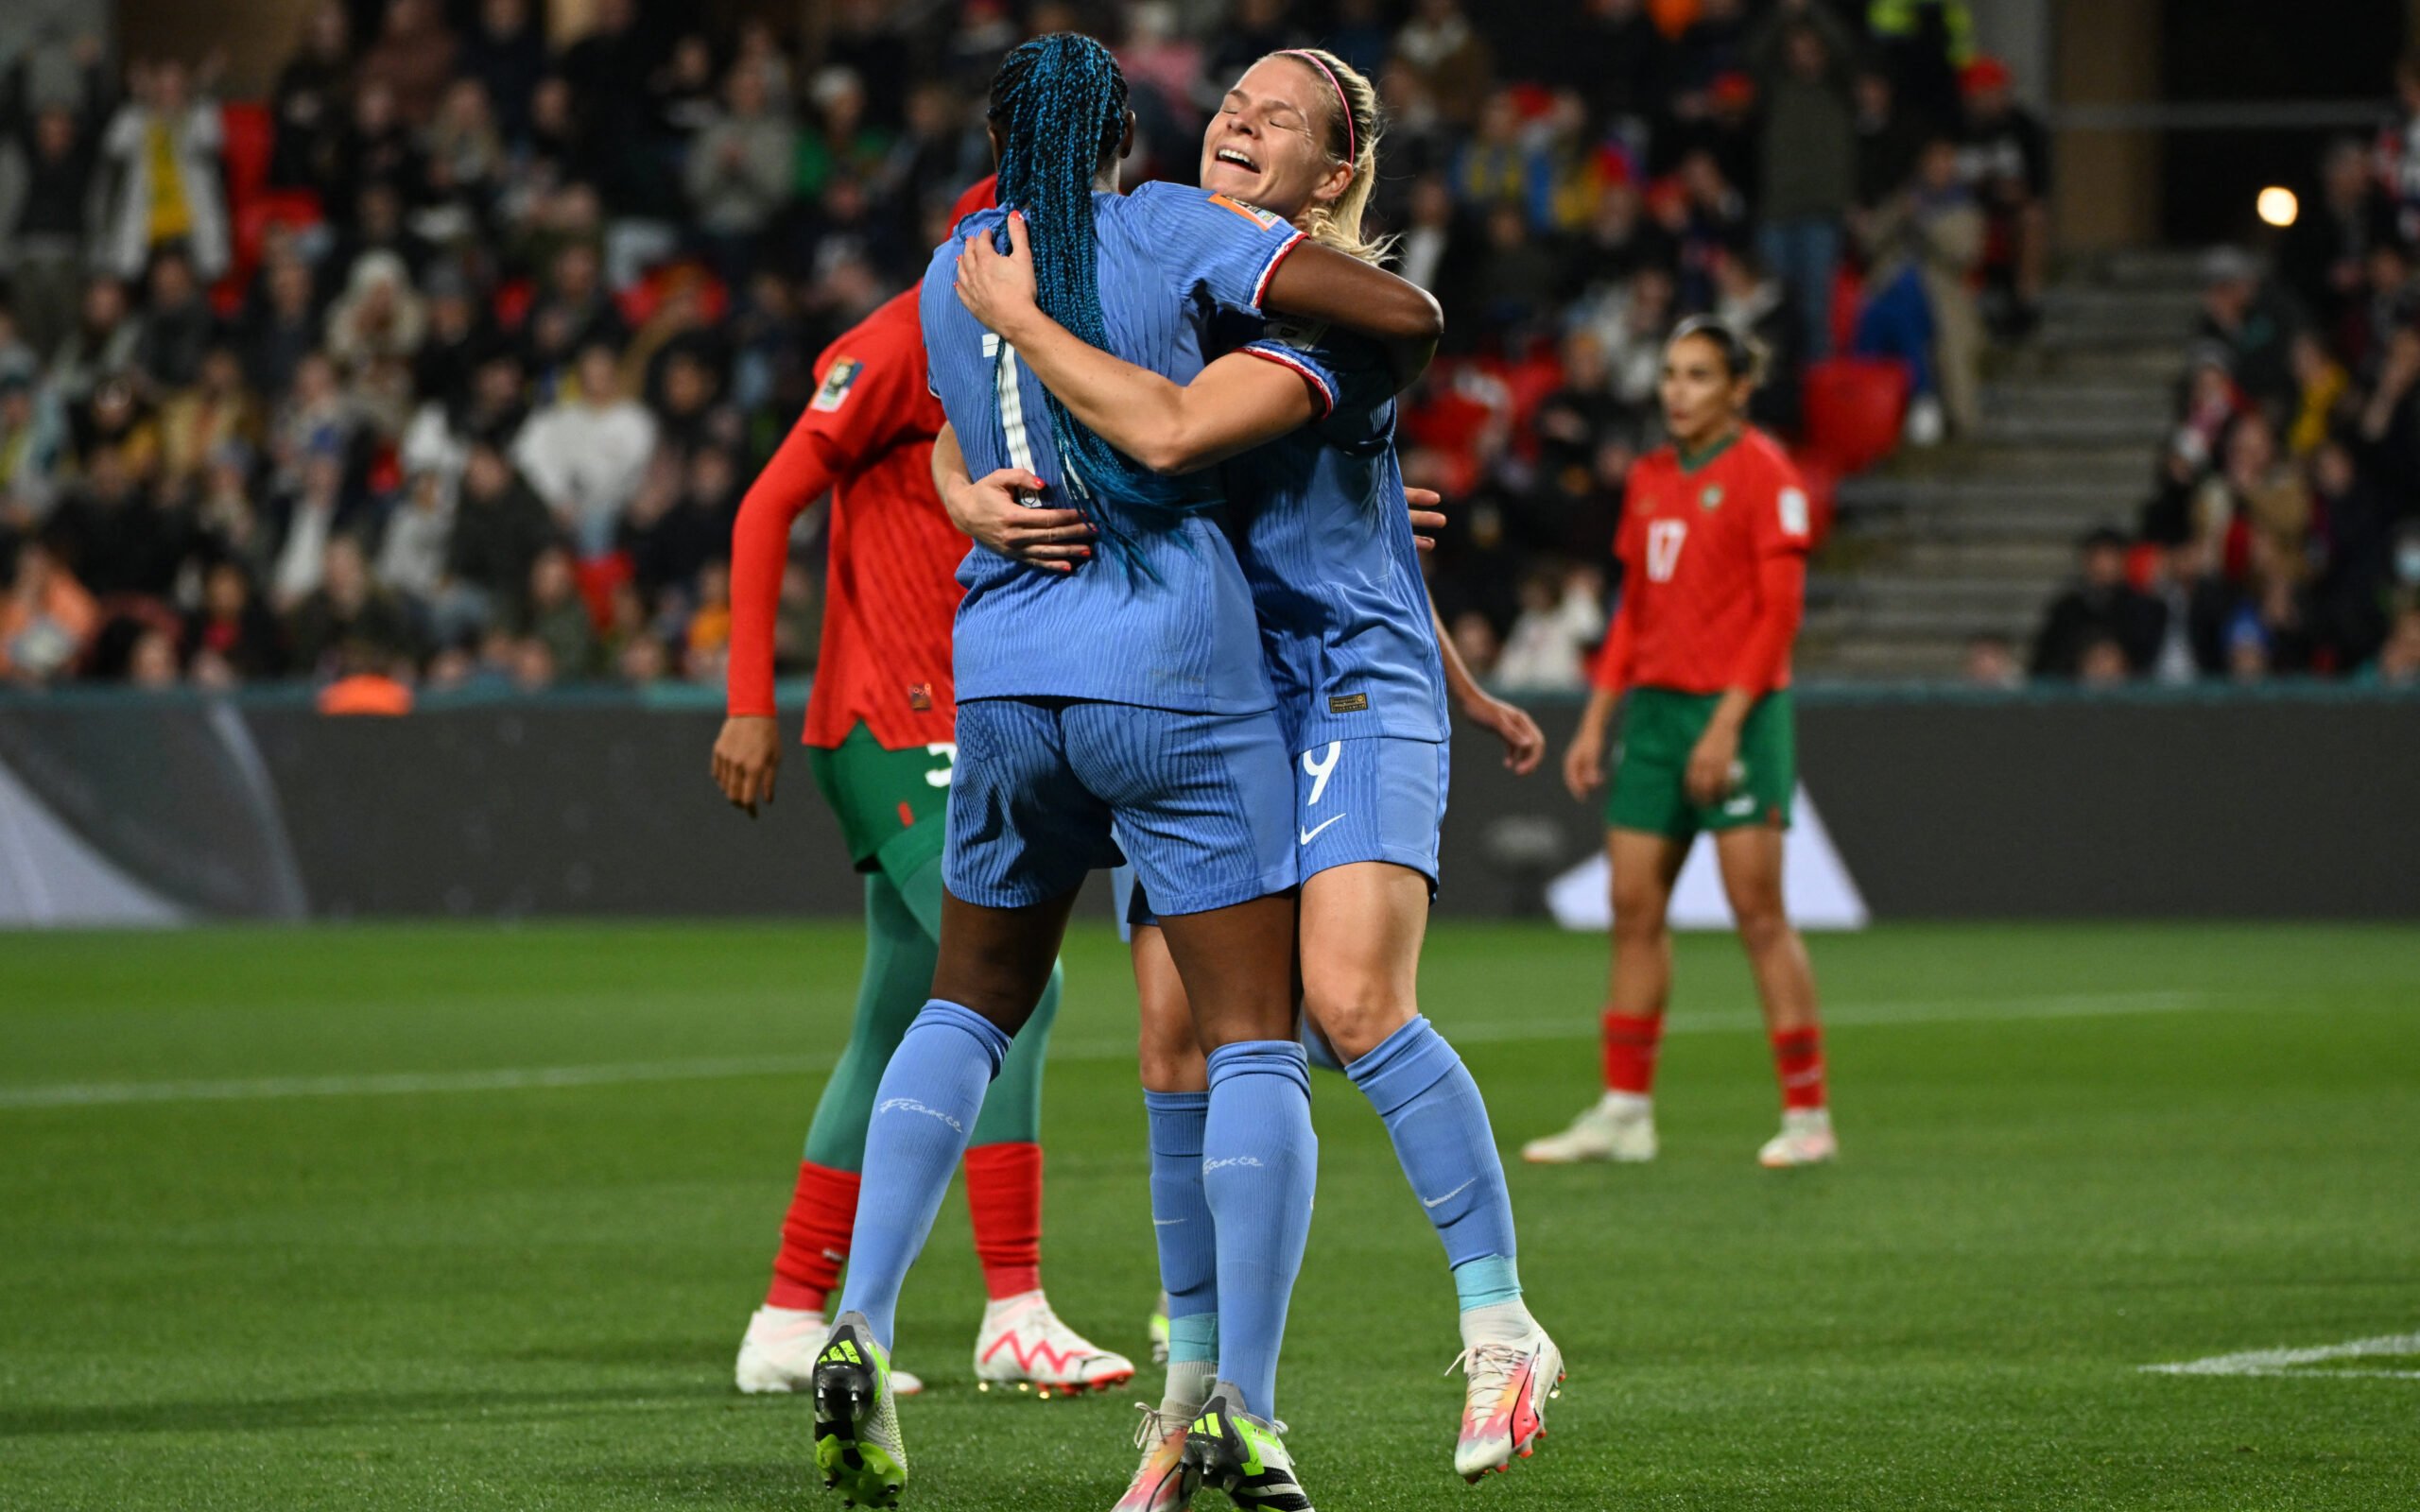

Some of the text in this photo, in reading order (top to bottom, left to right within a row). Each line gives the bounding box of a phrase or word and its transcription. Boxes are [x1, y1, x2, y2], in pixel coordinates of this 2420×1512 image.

[982, 333, 1089, 508] 1
[1648, 520, 1687, 583] 17
[1304, 741, 1340, 806] 9
